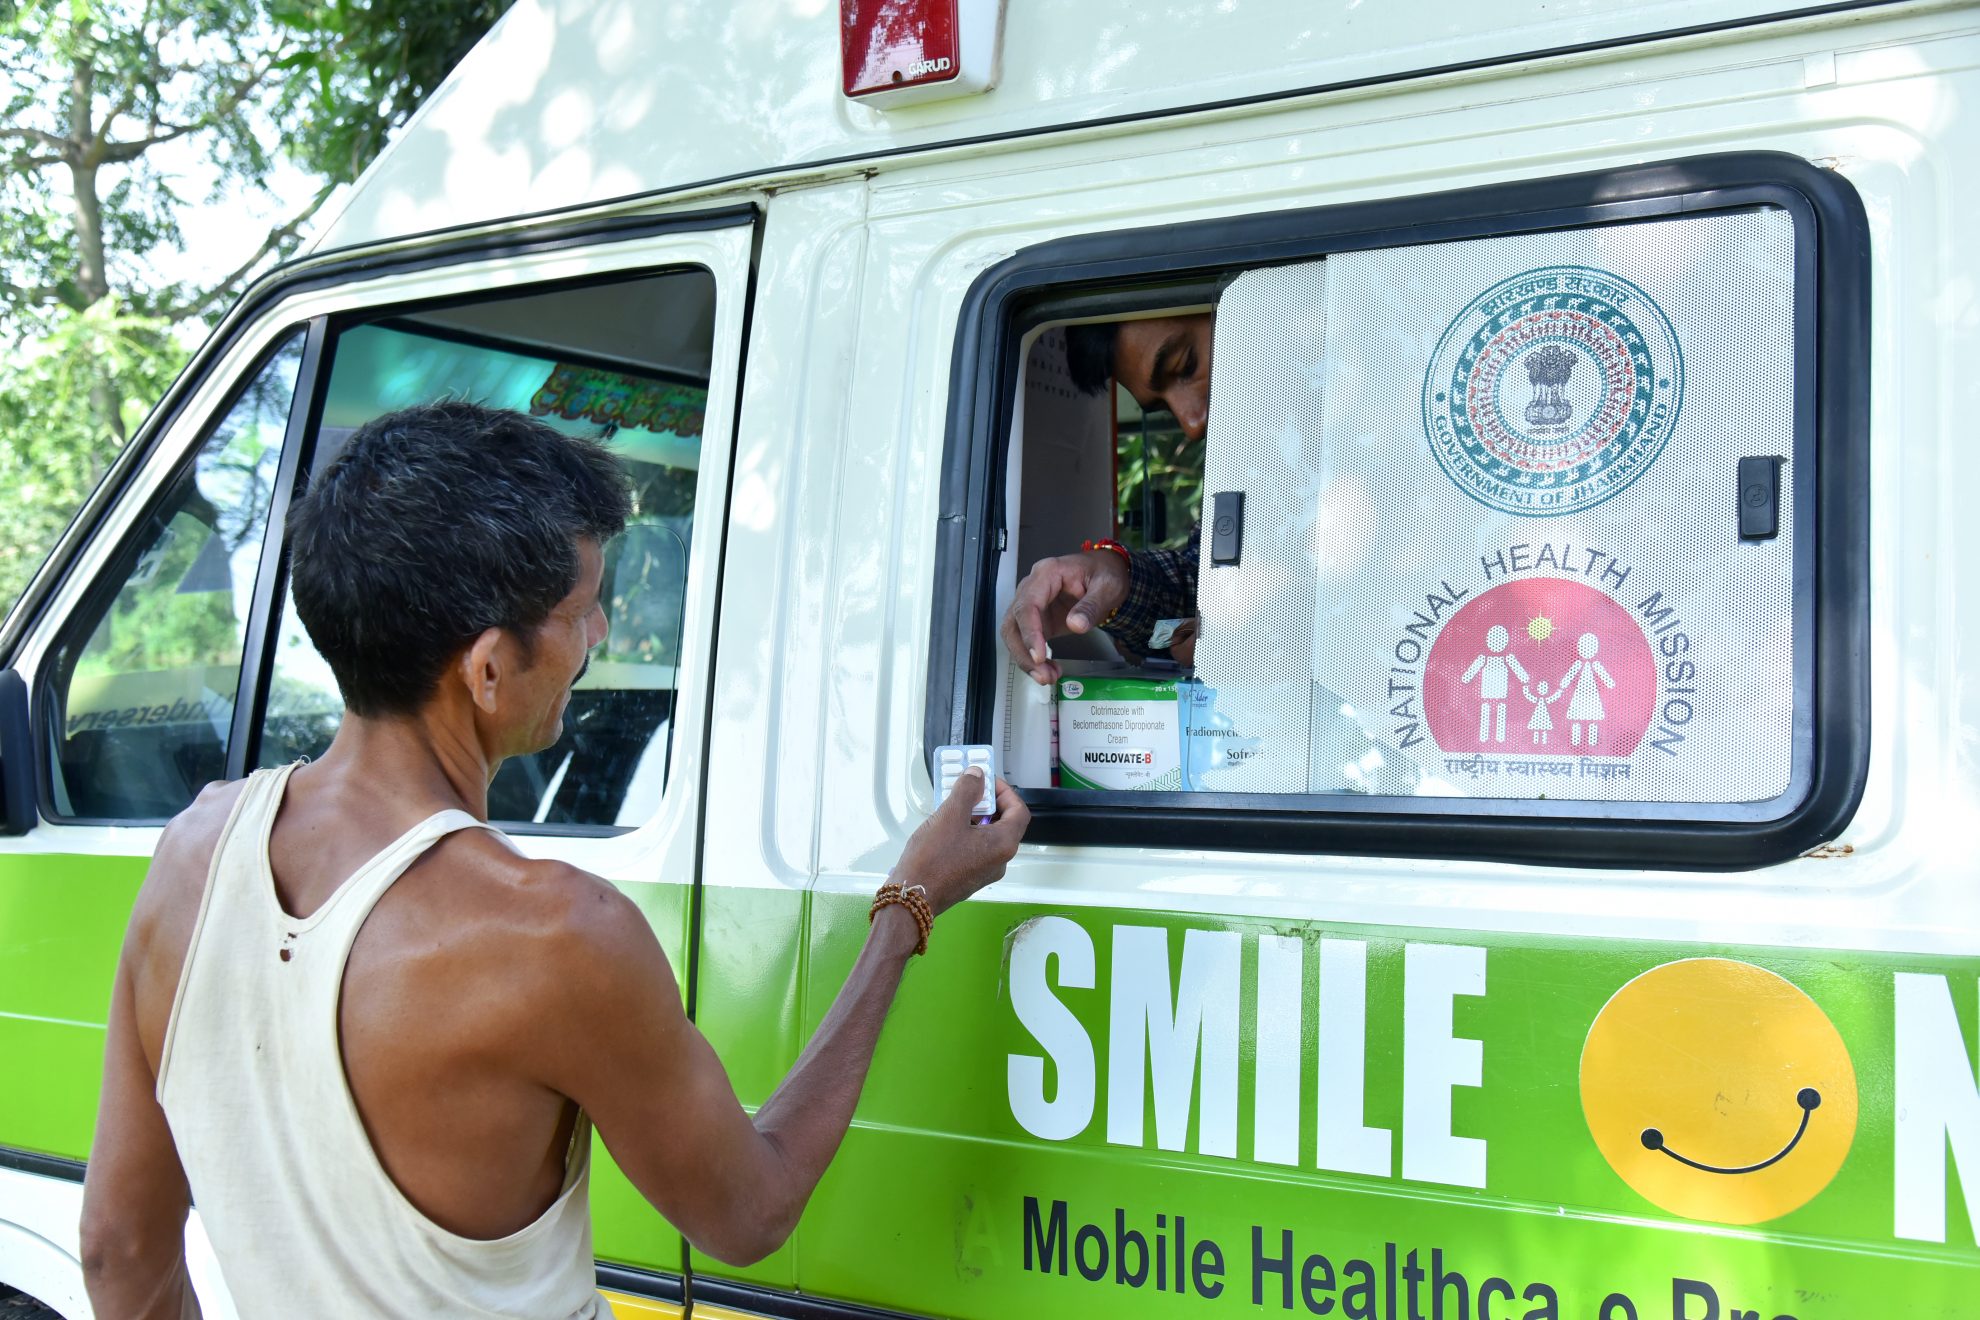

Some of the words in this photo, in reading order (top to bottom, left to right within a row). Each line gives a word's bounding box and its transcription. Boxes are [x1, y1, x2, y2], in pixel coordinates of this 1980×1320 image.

[908, 57, 950, 75] GARUD
[1565, 276, 1630, 307] सरकार
[1436, 415, 1532, 504] GOVERNMENT
[1540, 491, 1563, 505] OF
[1571, 403, 1668, 501] JHARKHAND
[1388, 580, 1469, 750] NATIONAL
[1480, 543, 1632, 590] HEALTH
[1637, 591, 1696, 756] MISSION
[1090, 705, 1130, 716] Clotrimazole
[1131, 706, 1145, 716] with
[1072, 720, 1123, 730] Beclomethasone
[1124, 720, 1165, 732] Dipropionate
[1107, 734, 1128, 744] Cream
[1084, 751, 1152, 764] NUCLOVATE-B
[1444, 754, 1500, 780] राष्ट्रीय
[1579, 757, 1632, 780] मिशन
[1006, 913, 1489, 1190] SMILE
[1023, 1195, 1226, 1300] Mobile
[1250, 1225, 1639, 1320] Healthca
